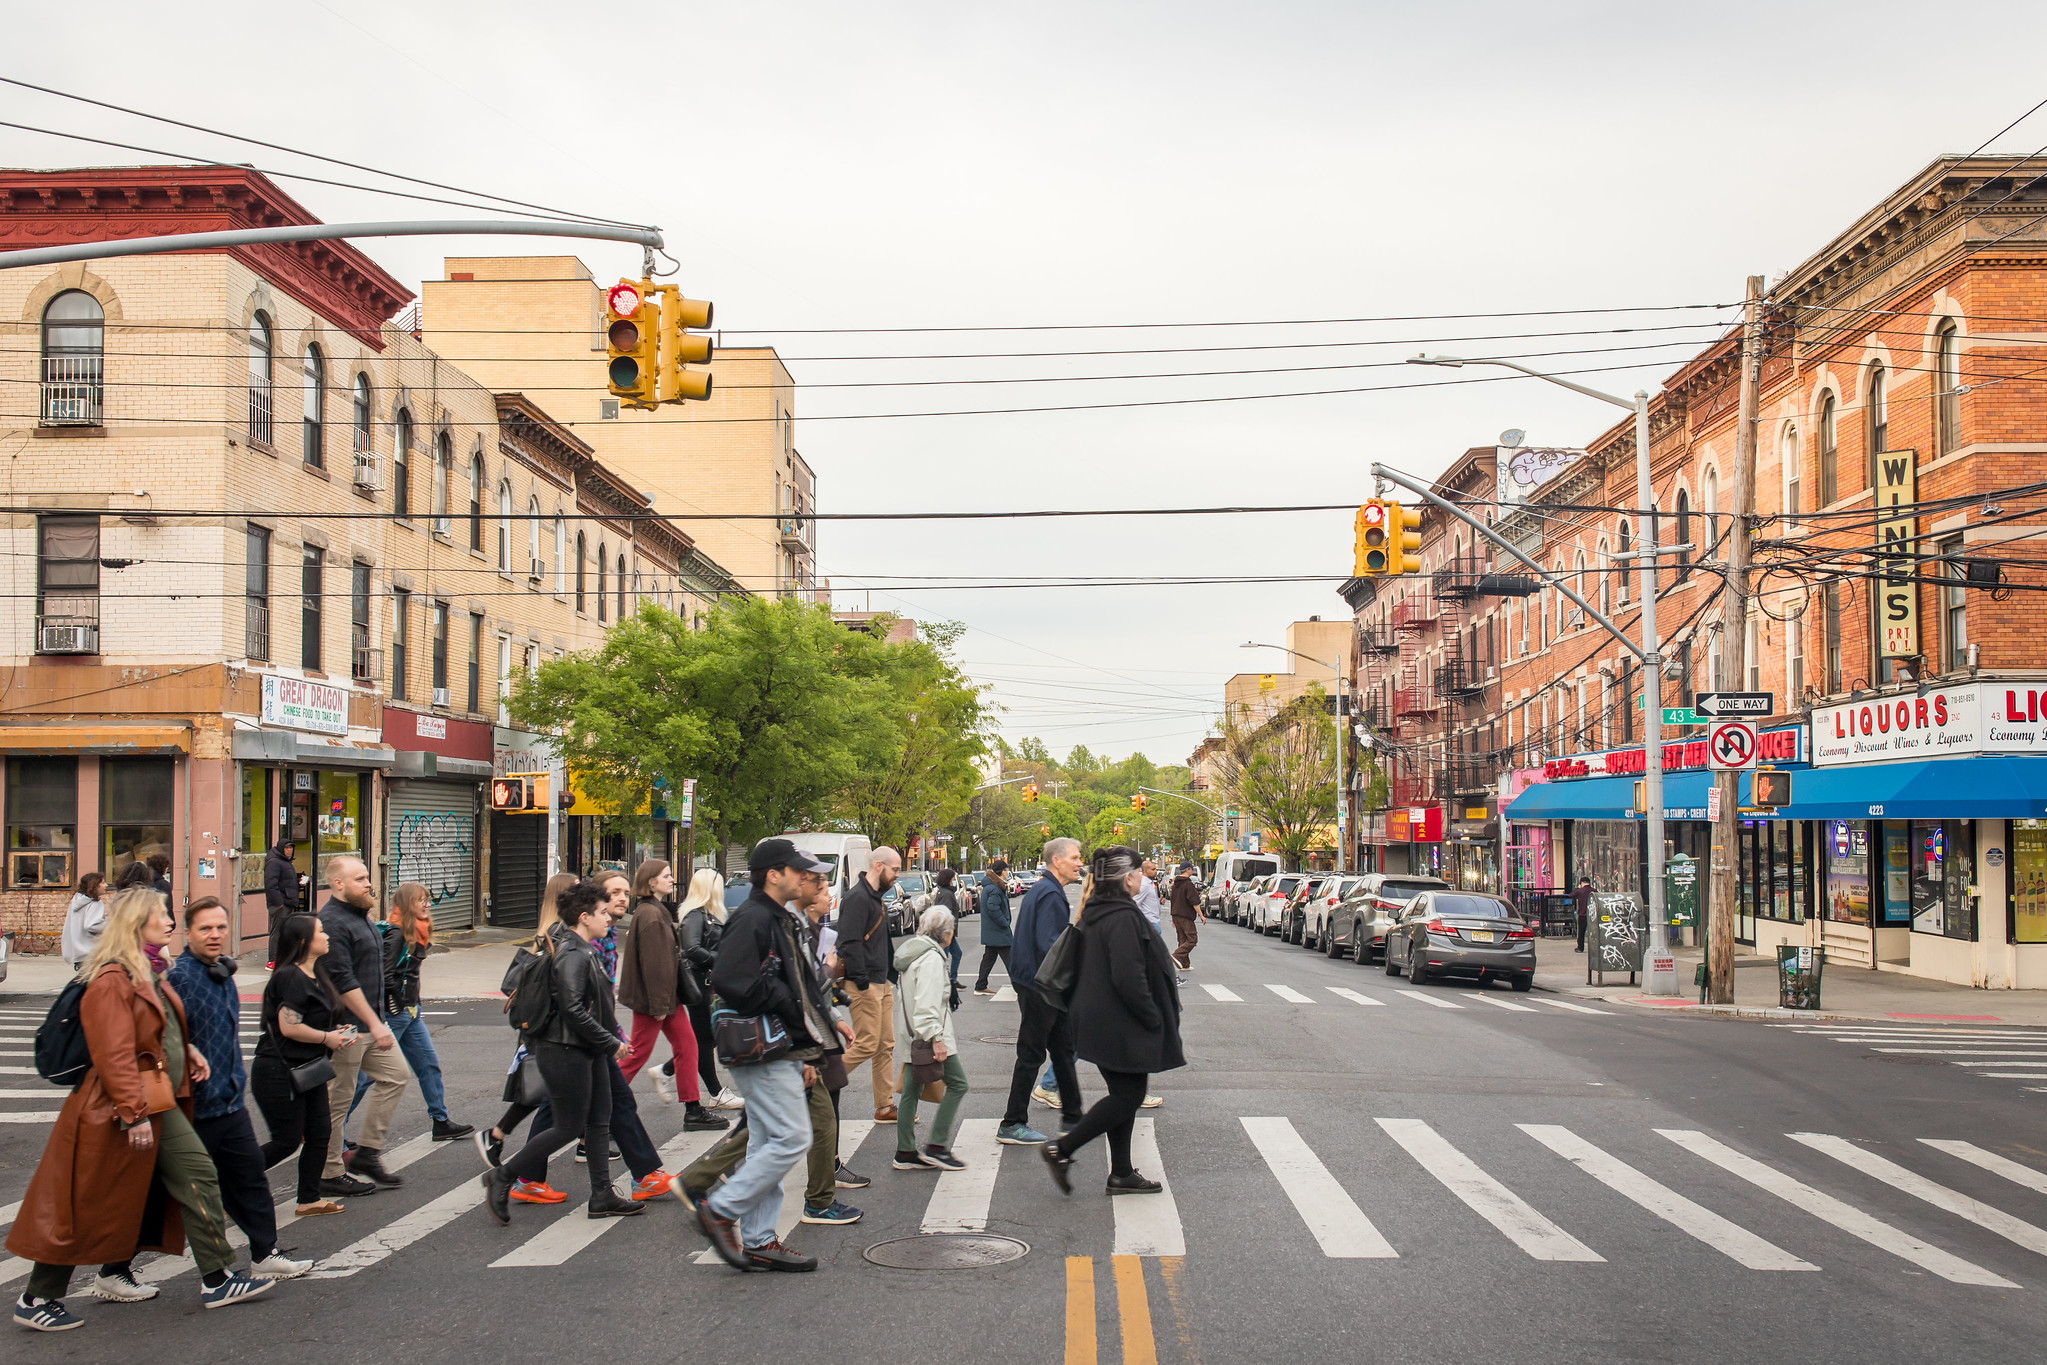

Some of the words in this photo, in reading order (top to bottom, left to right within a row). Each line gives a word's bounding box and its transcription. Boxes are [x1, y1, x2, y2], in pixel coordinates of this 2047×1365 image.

[1883, 458, 1909, 621] WINES
[280, 680, 307, 706] GREAT
[311, 685, 343, 712] DRAGON
[1718, 699, 1740, 710] ONE
[1743, 699, 1765, 710] WAY
[283, 704, 301, 718] CHINESE
[303, 708, 314, 719] FOOD
[315, 710, 320, 721] TO
[322, 711, 332, 723] TAKE
[333, 713, 341, 724] OUT
[1669, 710, 1685, 723] 43
[1836, 694, 1948, 739] LIQUORS
[1991, 712, 2001, 721] 43
[1819, 745, 1850, 758] Economy
[1854, 740, 1888, 753] Discount
[1893, 736, 1919, 750] Wines
[1924, 733, 1931, 745] &
[1937, 731, 1974, 748] Liquors
[1990, 727, 2036, 746] Economy
[1556, 758, 1588, 777] Placita
[1605, 744, 1682, 775] SUPERMKET
[1684, 741, 1708, 768] MEA
[296, 773, 309, 787] 4224
[1670, 808, 1687, 819] STAMPS
[1690, 808, 1707, 819] CREDIT
[1868, 804, 1884, 816] 4223
